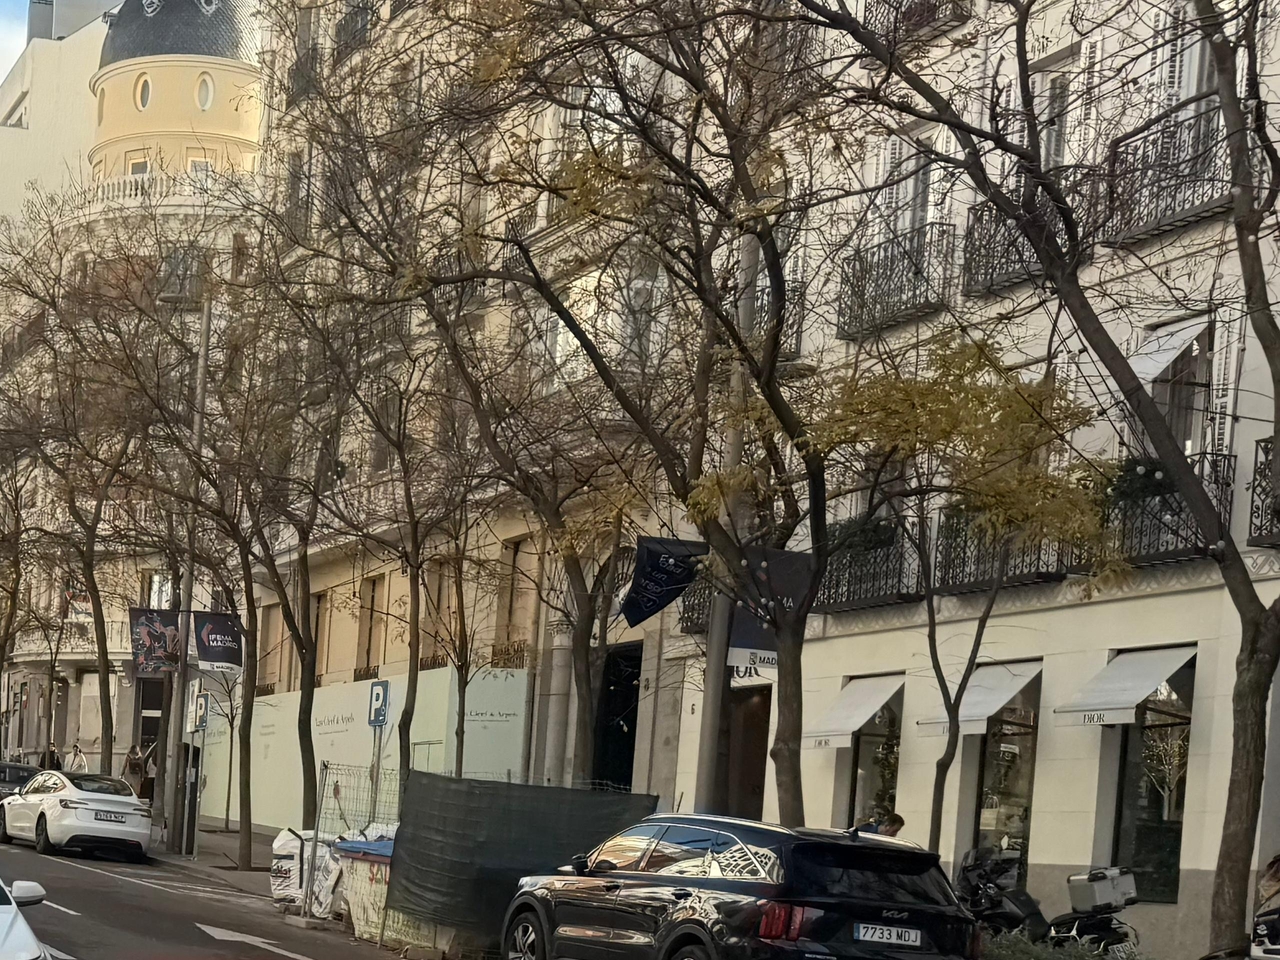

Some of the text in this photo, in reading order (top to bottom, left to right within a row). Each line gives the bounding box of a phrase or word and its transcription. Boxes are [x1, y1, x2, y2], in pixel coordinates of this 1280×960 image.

[759, 656, 777, 665] MAD
[196, 697, 206, 726] P
[370, 685, 384, 721] P
[1083, 713, 1105, 723] DIOR
[862, 926, 919, 943] 7733 MDJ
